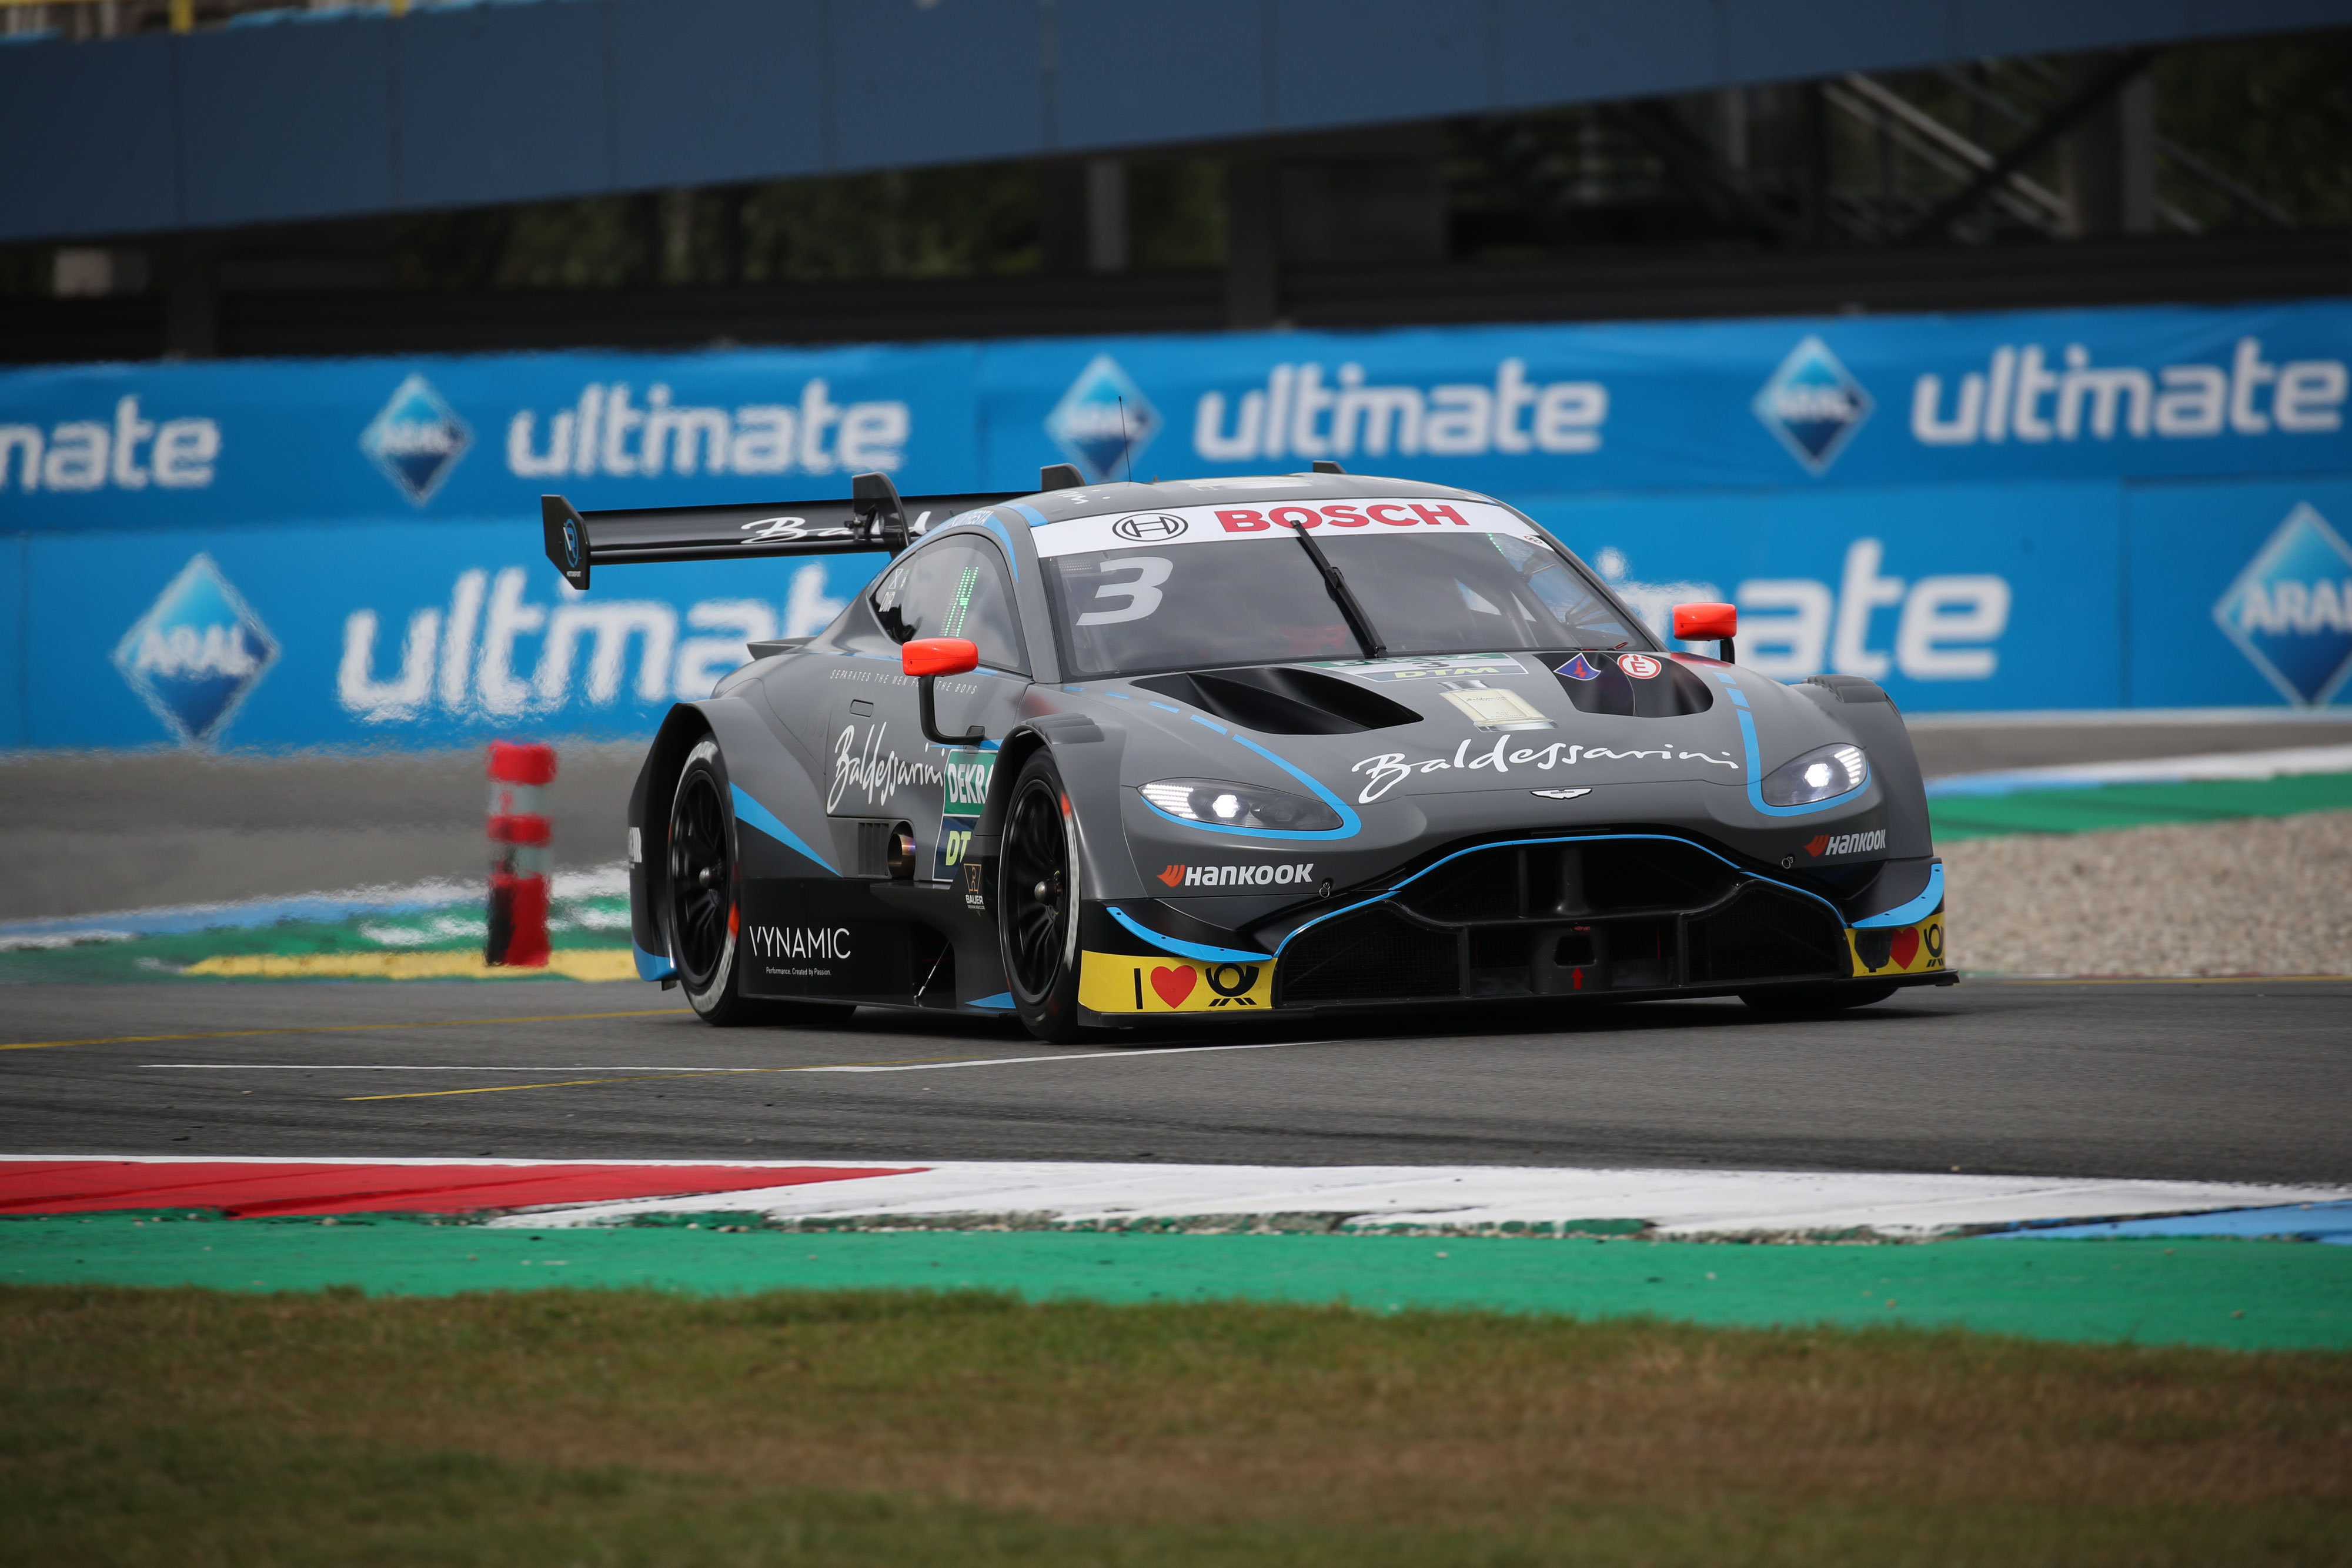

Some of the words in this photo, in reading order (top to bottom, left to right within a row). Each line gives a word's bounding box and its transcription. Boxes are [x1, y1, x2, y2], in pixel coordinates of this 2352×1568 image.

[1194, 357, 1609, 461] ultimate
[1909, 336, 2348, 445] ultimate
[506, 377, 911, 479] ultimate
[1214, 503, 1471, 533] BOSCH
[1075, 556, 1174, 626] 3
[830, 669, 871, 682] SEPARATES
[874, 673, 888, 684] THE
[891, 676, 907, 687] MEN
[936, 681, 952, 691] THE
[954, 683, 977, 694] BOYS
[1394, 667, 1500, 678] DTM
[827, 721, 945, 814] Baldessarini
[1351, 734, 1739, 804] Baldessarini
[946, 830, 972, 867] DT
[965, 894, 984, 905] BAUER
[749, 925, 851, 959] VYNAMIC
[766, 966, 791, 975] Performance.
[792, 967, 808, 975] Created
[808, 968, 814, 977] by
[814, 967, 831, 975] Passion.
